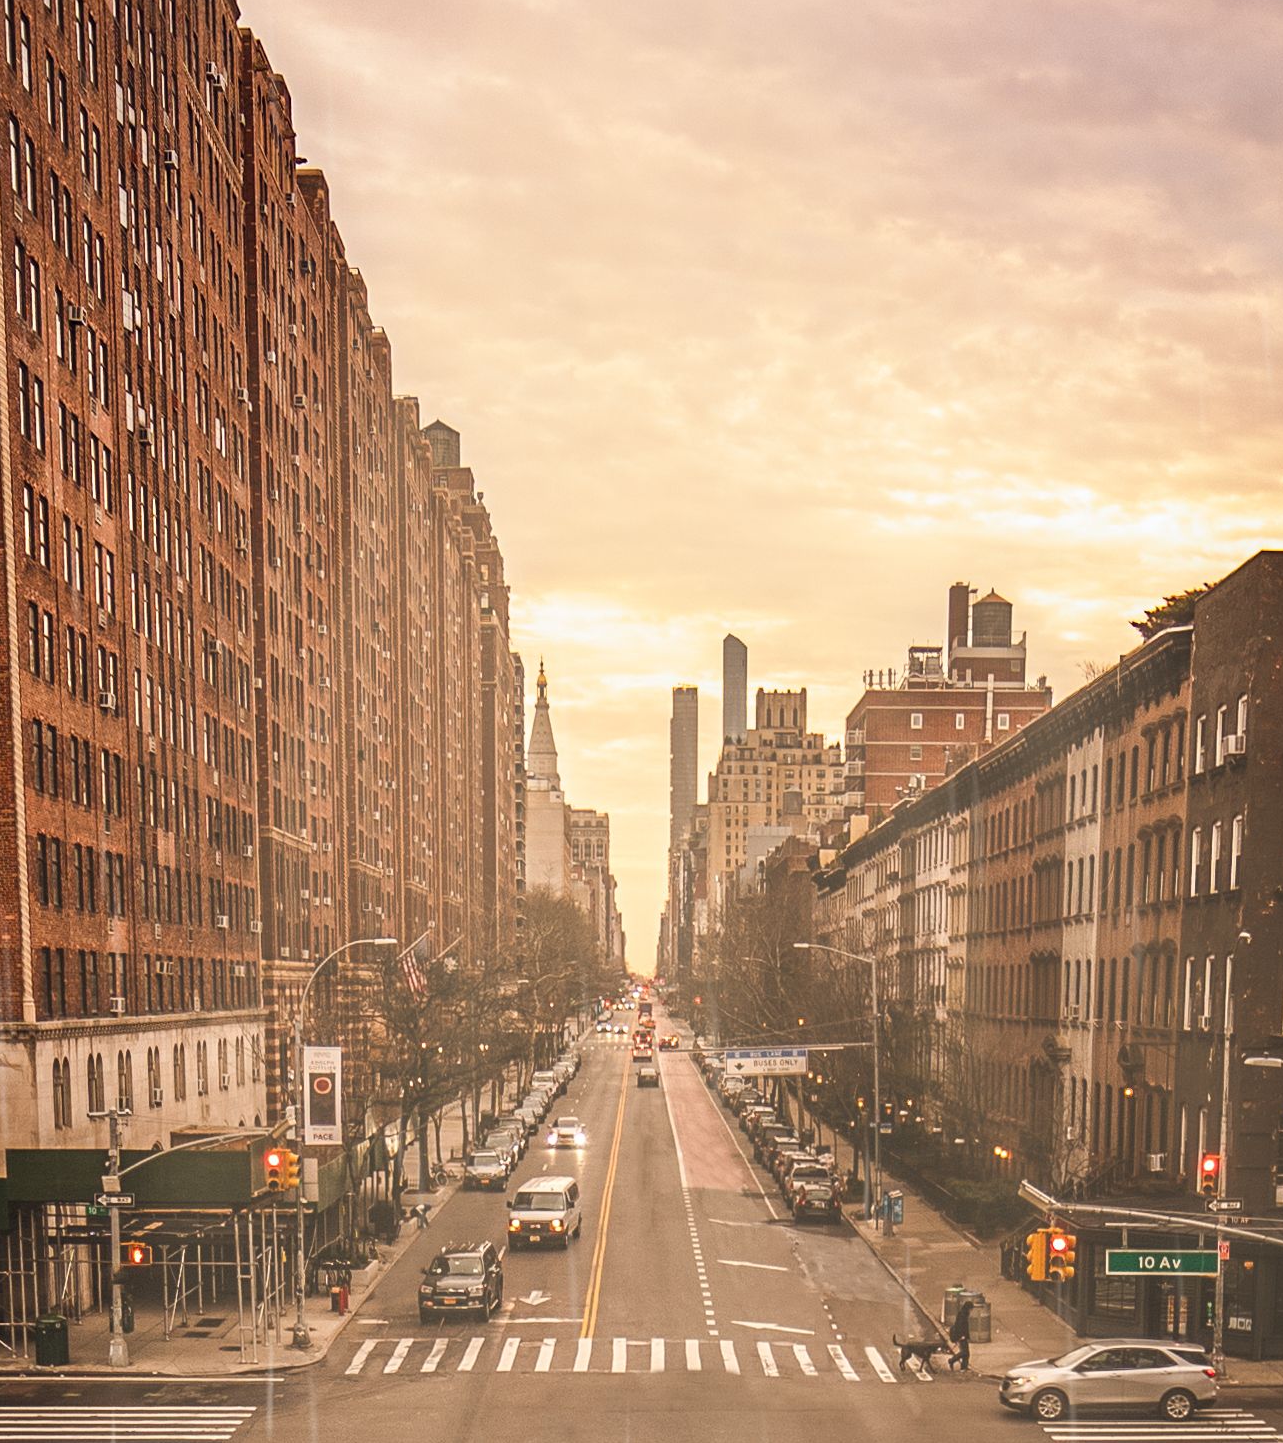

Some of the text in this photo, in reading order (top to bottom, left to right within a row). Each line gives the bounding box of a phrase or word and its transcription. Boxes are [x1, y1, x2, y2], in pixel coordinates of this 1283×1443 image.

[780, 1058, 798, 1066] ONLY
[1138, 1256, 1182, 1269] 10 Av
